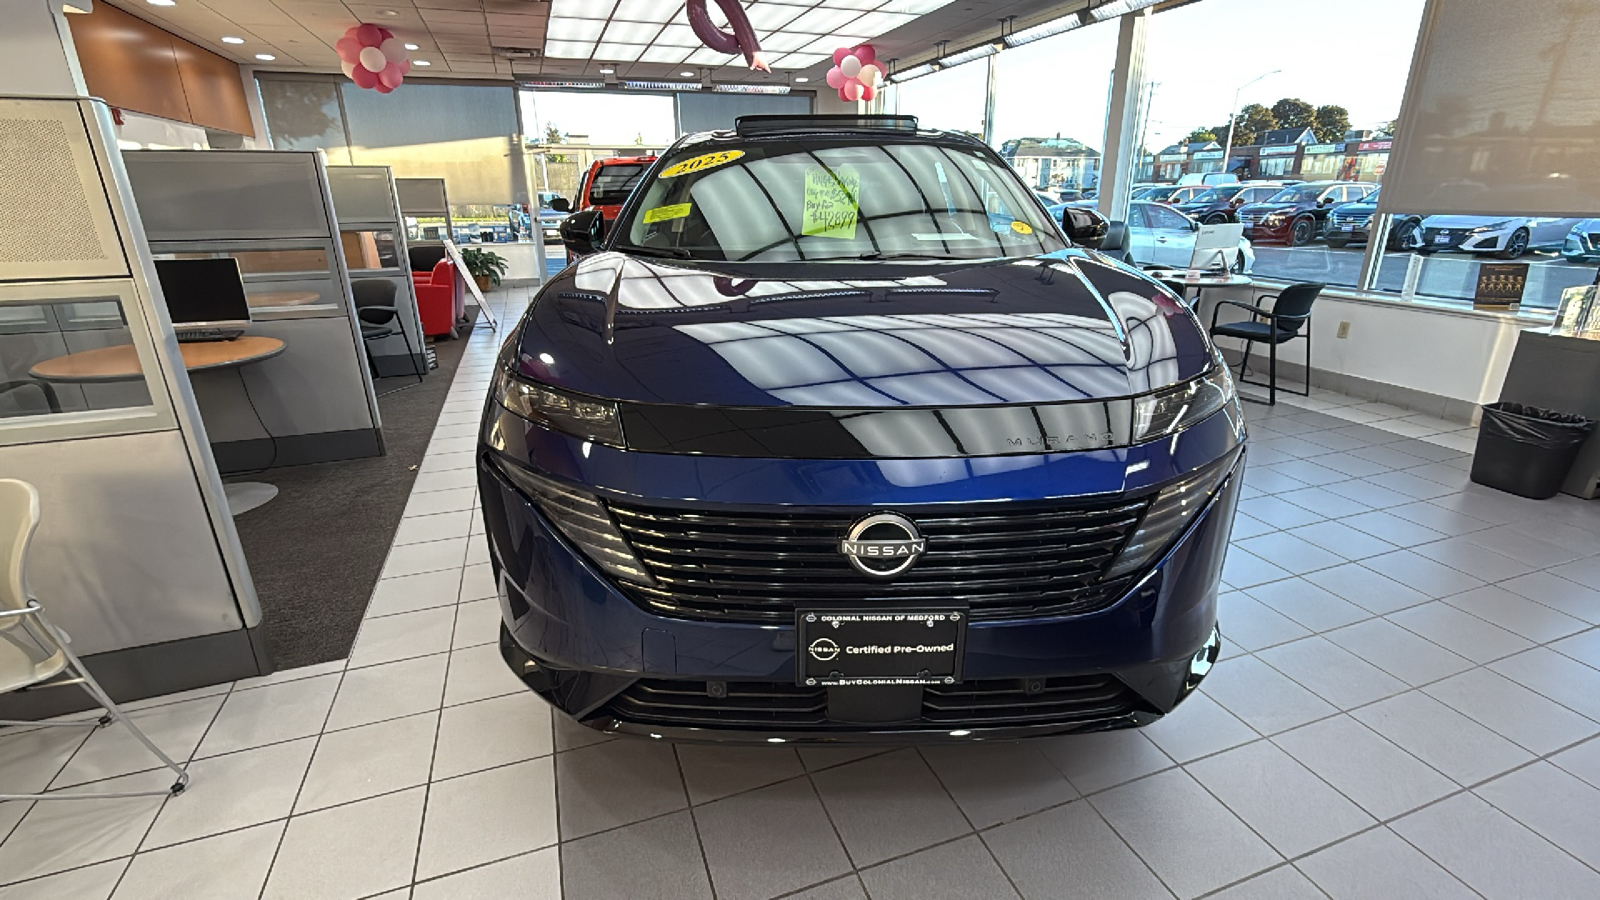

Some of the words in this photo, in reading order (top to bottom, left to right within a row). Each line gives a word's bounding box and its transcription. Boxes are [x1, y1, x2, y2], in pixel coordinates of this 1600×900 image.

[674, 151, 732, 174] 2025
[809, 209, 856, 232] $42899
[1006, 430, 1114, 447] MURANO
[843, 542, 925, 556] NISSAN
[907, 614, 946, 622] MEDFORD
[846, 645, 892, 654] Certified
[893, 643, 954, 654] Pre-Owned
